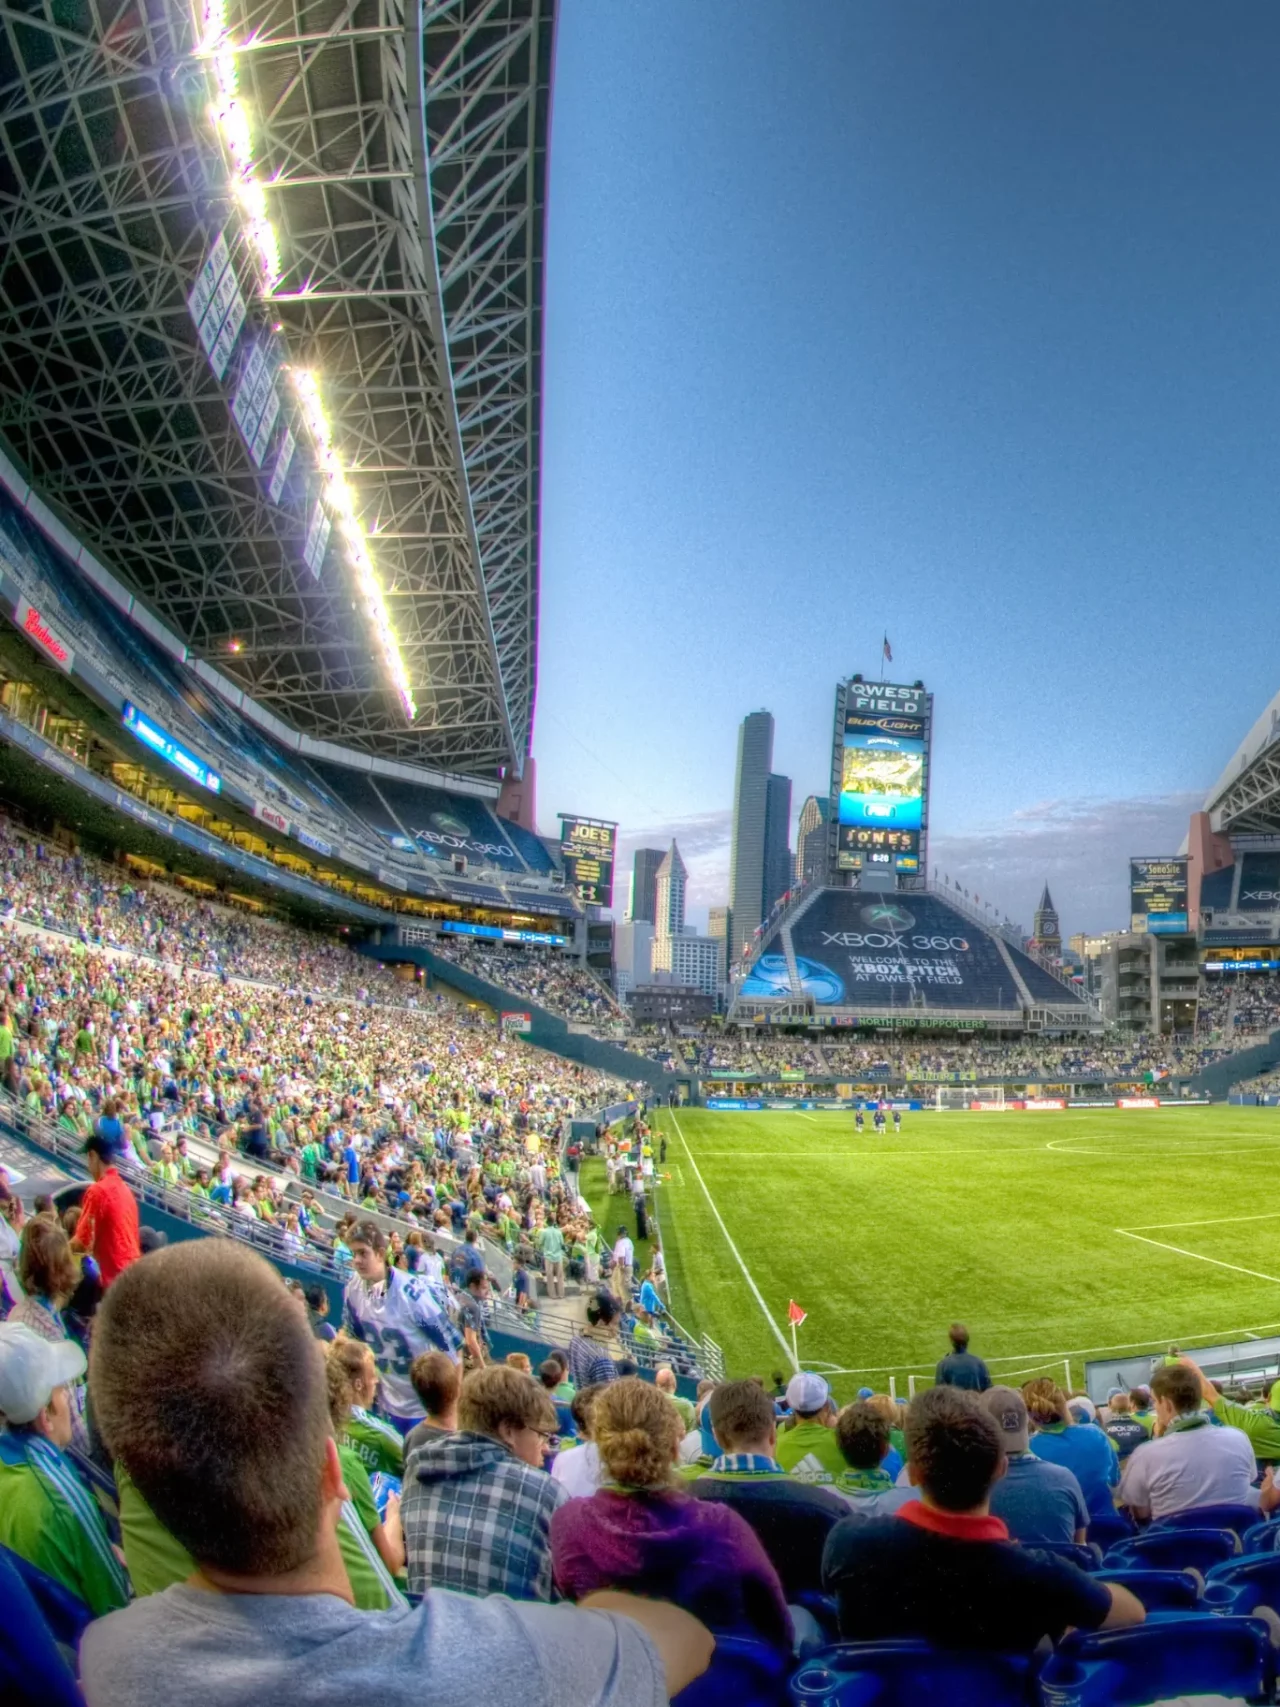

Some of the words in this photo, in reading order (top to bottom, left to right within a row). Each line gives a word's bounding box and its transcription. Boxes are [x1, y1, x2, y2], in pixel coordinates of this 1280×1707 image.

[851, 683, 924, 700] QWEST
[856, 697, 918, 713] FIELD
[410, 828, 473, 852] XBOX
[472, 841, 514, 857] 360
[846, 829, 912, 846] JONES
[1148, 863, 1181, 875] SonoSite
[821, 931, 909, 949] XBOX
[912, 935, 970, 951] 360
[849, 955, 911, 966] WELCOME
[916, 957, 930, 966] TO
[932, 958, 956, 967] THE
[852, 963, 903, 975] XBOX
[904, 964, 961, 977] PITCH
[856, 973, 870, 982] AT
[875, 973, 923, 984] QWEST
[927, 974, 964, 985] FIELD
[859, 1018, 893, 1027] NORTH
[896, 1018, 916, 1027] END
[919, 1018, 985, 1029] SUPPORTERS
